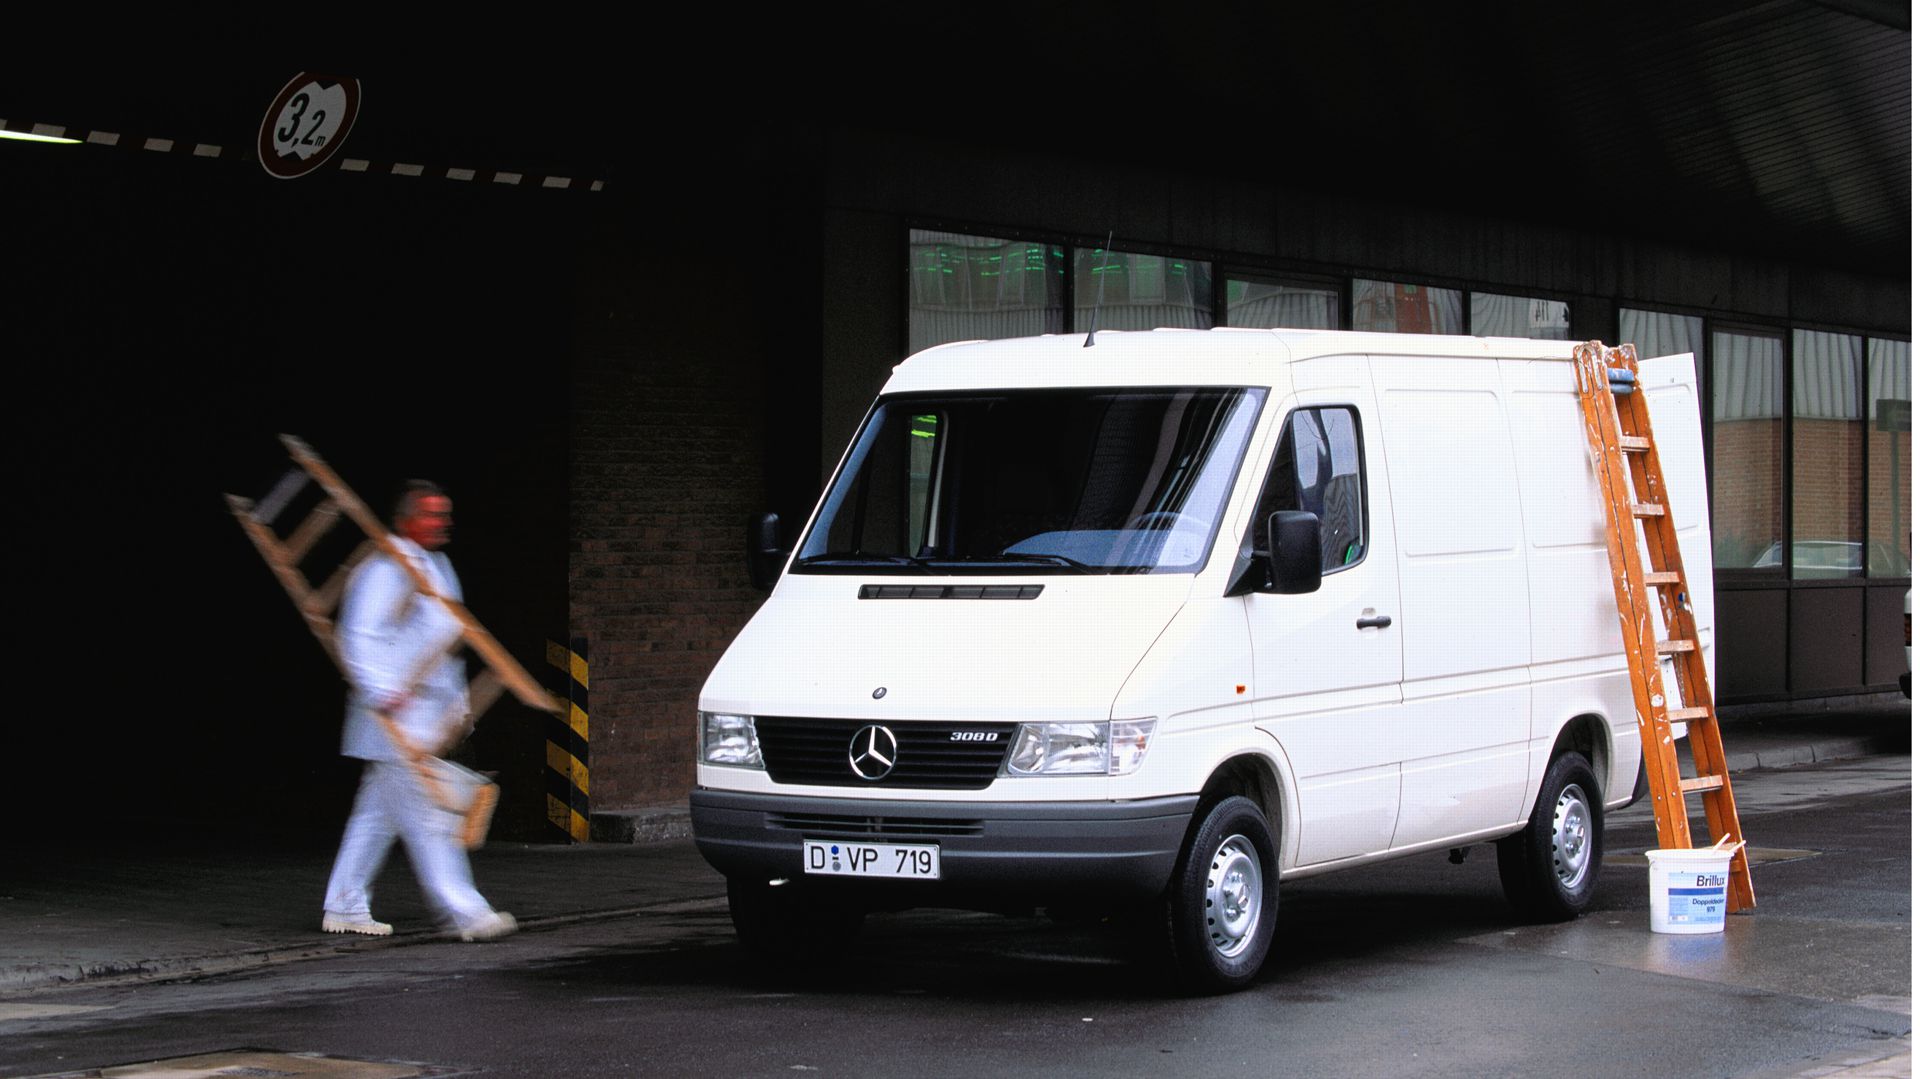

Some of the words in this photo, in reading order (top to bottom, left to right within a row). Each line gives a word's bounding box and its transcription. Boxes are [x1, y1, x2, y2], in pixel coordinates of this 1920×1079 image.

[950, 732, 985, 741] 308
[810, 846, 826, 869] D
[847, 847, 878, 872] VP
[895, 850, 932, 874] 719
[1696, 875, 1725, 887] Brillux
